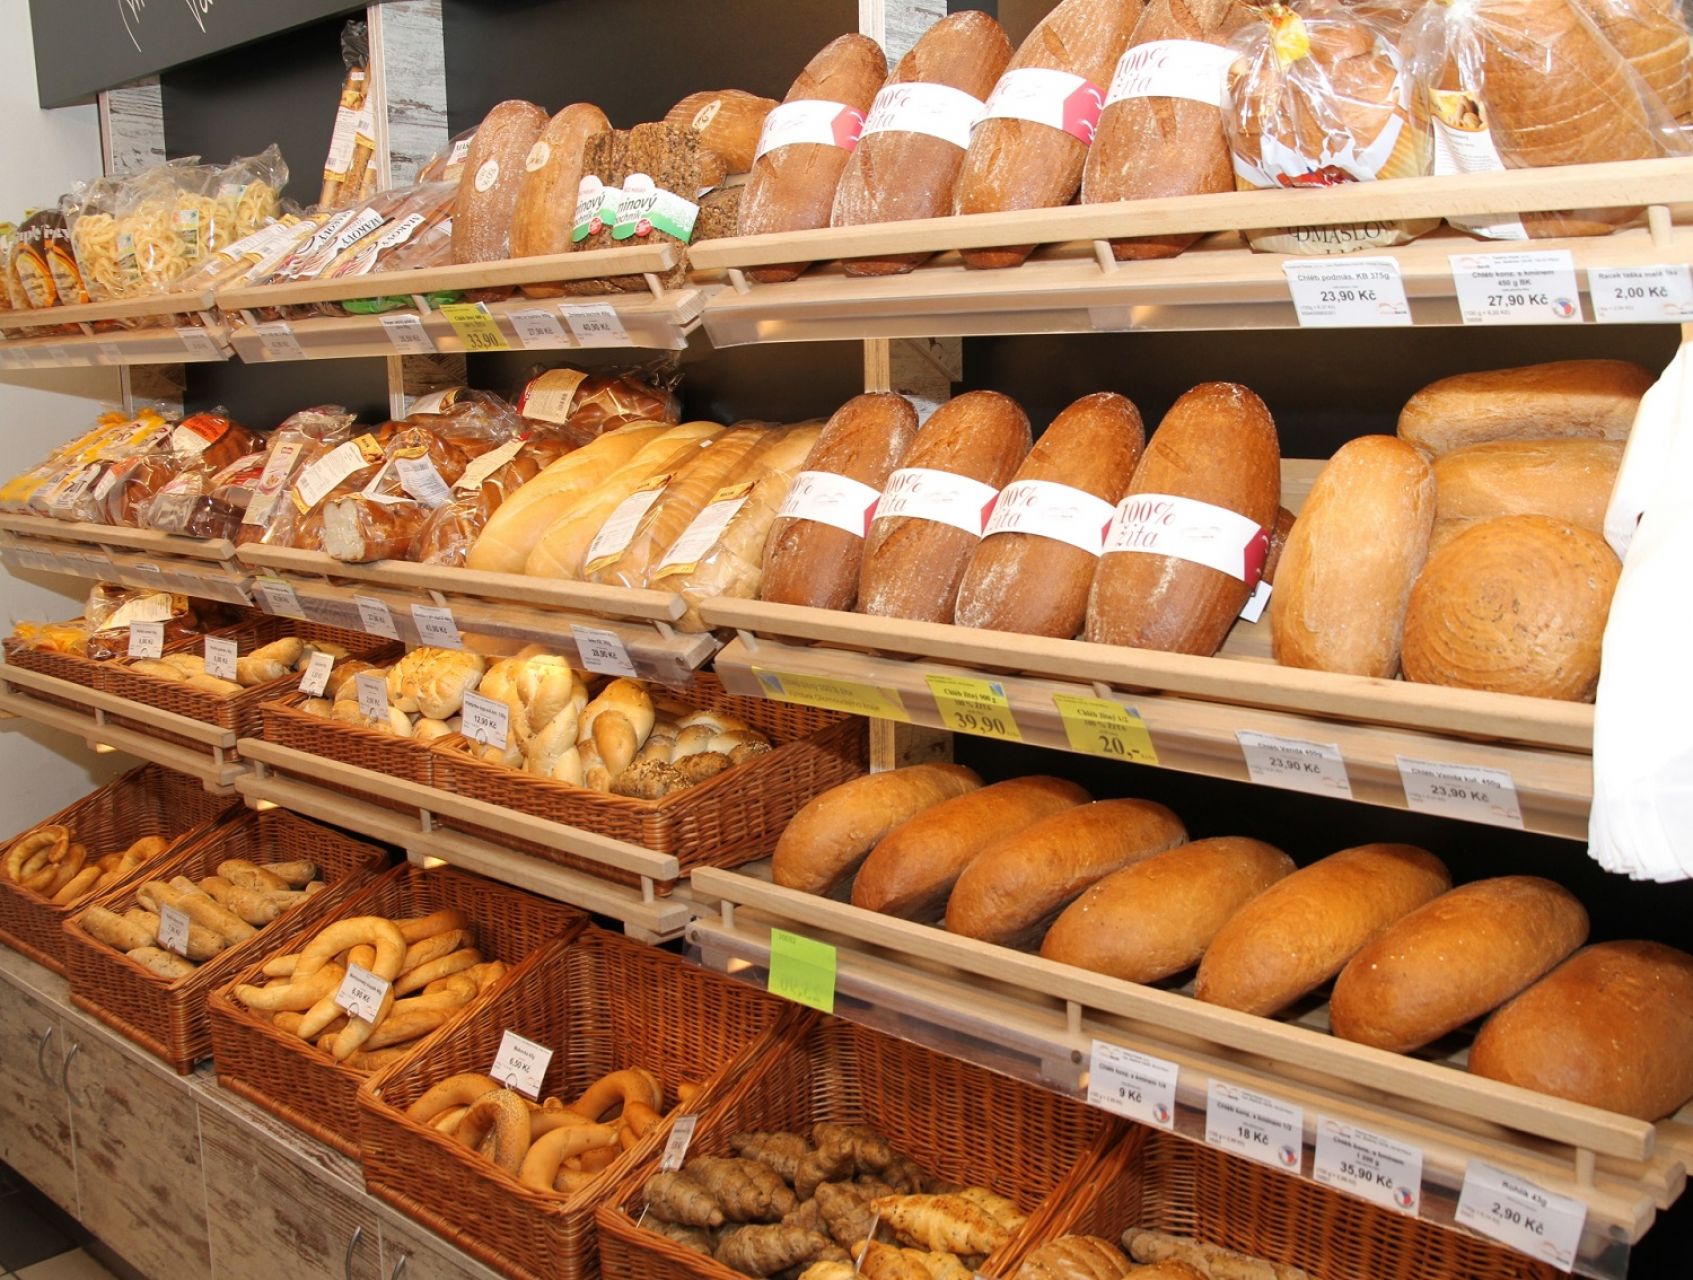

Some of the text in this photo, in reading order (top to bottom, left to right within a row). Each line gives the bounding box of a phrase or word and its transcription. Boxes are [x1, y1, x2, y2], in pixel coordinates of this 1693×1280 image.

[1320, 289, 1377, 304] 23,90 Kč
[1488, 293, 1549, 308] 27,90 Kč
[1614, 286, 1668, 300] 2,00 Kč
[1119, 500, 1177, 527] 100%
[954, 711, 1006, 735] 39,90
[1098, 734, 1141, 761] 20,-
[1268, 756, 1322, 774] 23,90 Kč
[1430, 784, 1490, 803] 23,90 Kč
[1119, 1086, 1126, 1098] 9
[1128, 1089, 1143, 1104] Kč
[1238, 1125, 1251, 1140] 18
[1253, 1130, 1270, 1146] Kč
[1339, 1160, 1373, 1182] 35,90
[1376, 1173, 1393, 1190] Kč
[1491, 1201, 1522, 1225] 2,90
[1524, 1216, 1545, 1237] Kč
